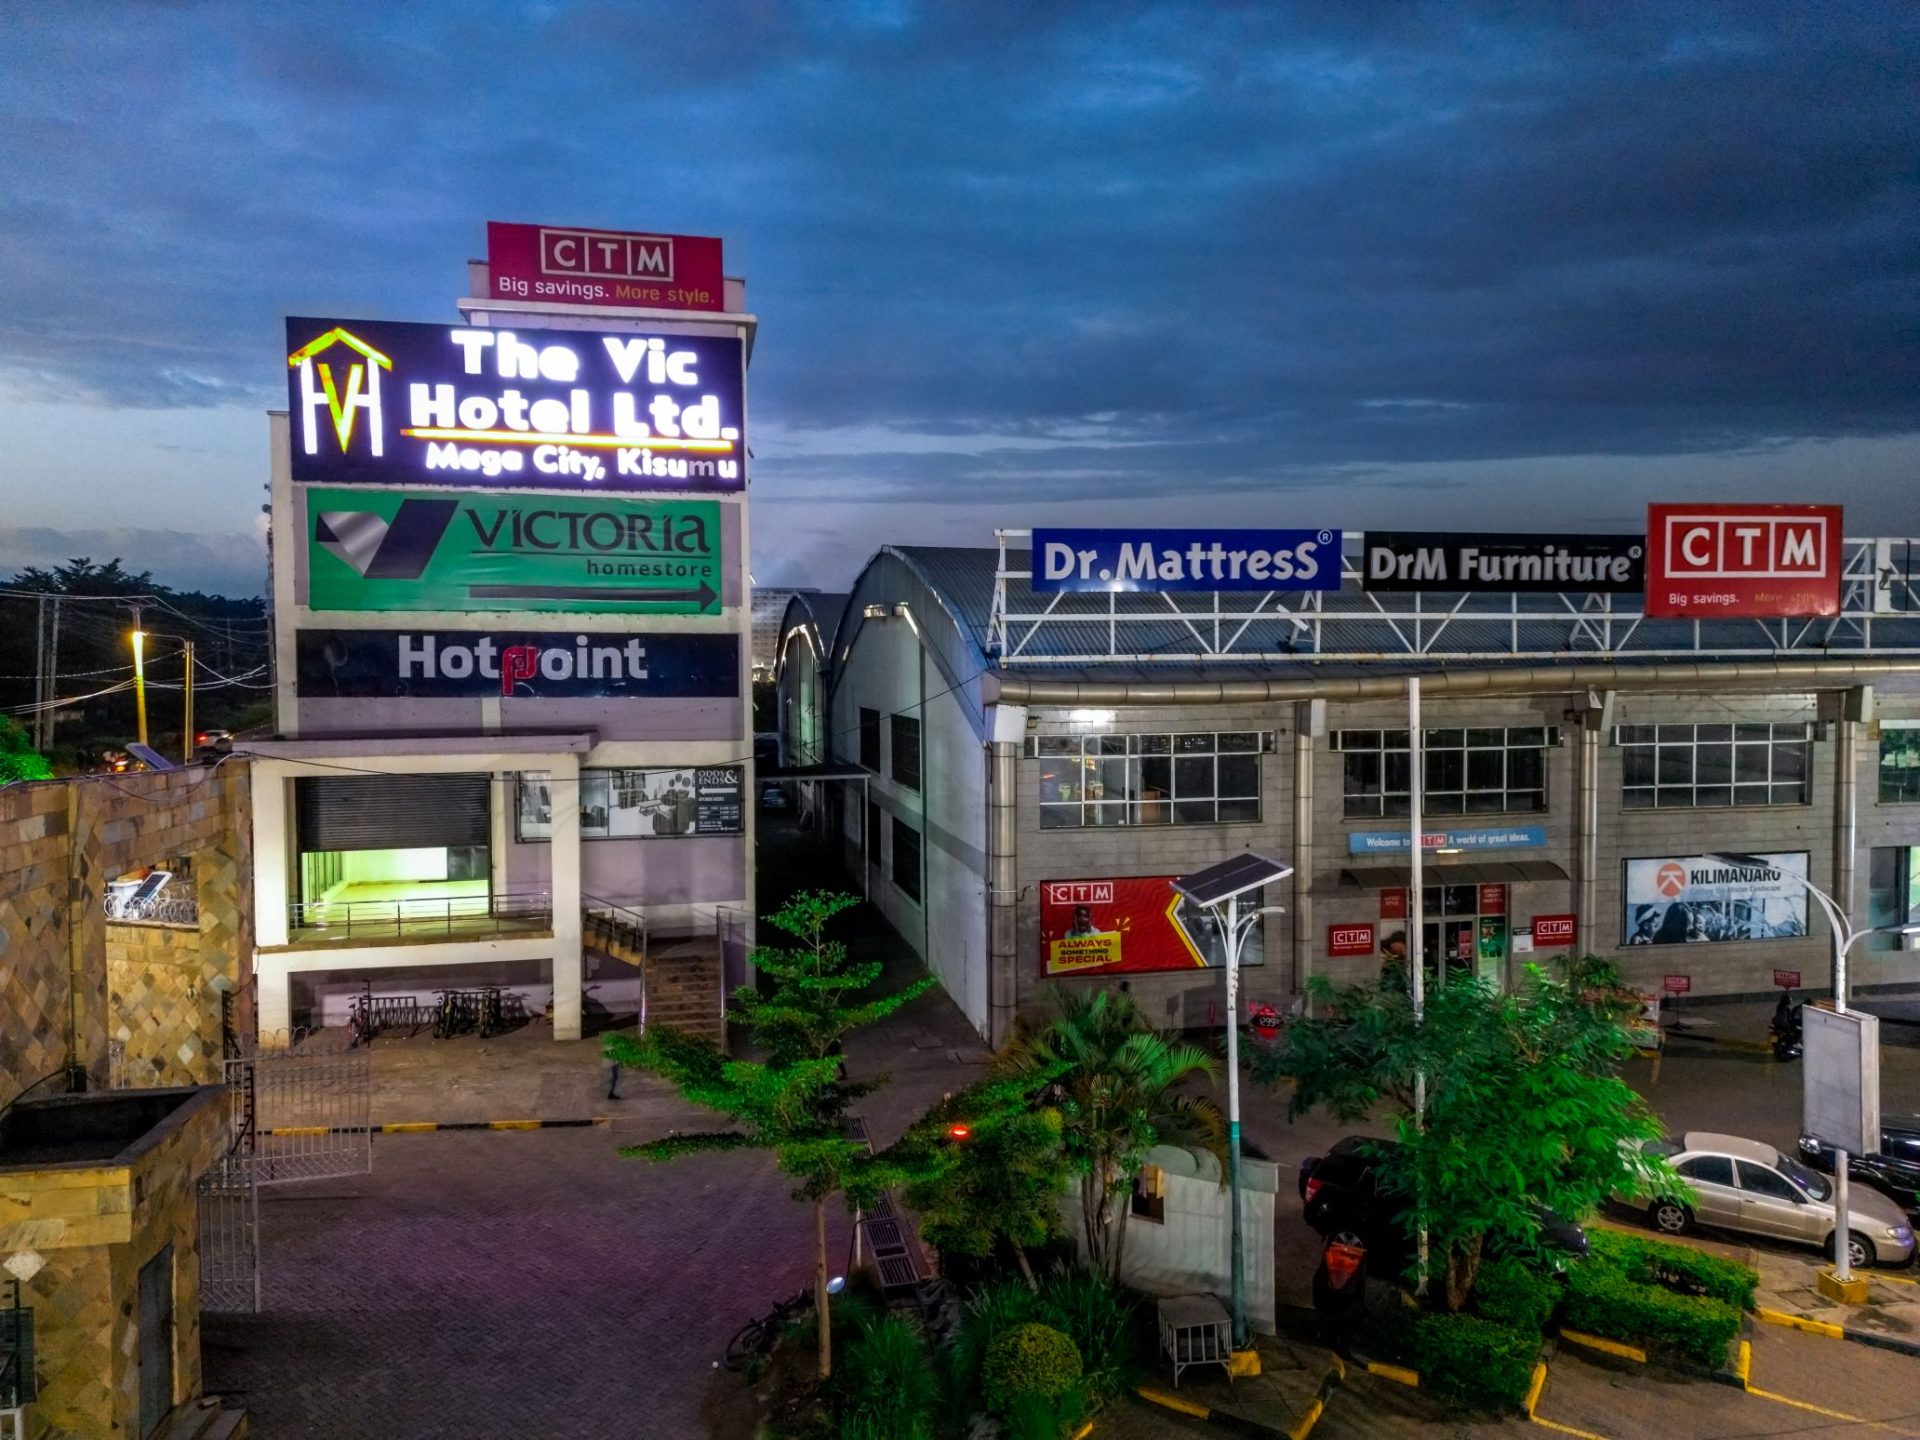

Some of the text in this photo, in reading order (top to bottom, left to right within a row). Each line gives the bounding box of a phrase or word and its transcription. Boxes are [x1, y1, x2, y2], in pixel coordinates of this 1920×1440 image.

[554, 240, 665, 273] CTM
[499, 277, 715, 305] Big savings. More style.
[451, 330, 698, 385] The Vic
[410, 383, 739, 439] Hotel Ltd.
[425, 442, 738, 480] Mega City, Kisumu
[1682, 527, 1816, 567] CTM
[586, 559, 712, 577] homestore
[1371, 547, 1447, 581] DrM
[1669, 593, 1688, 606] Big
[1693, 593, 1739, 606] savings.
[398, 635, 649, 696] Hotpoint
[1366, 837, 1400, 847] Welcome
[1402, 838, 1411, 846] to
[1056, 886, 1110, 900] CTM
[1540, 923, 1571, 933] CTM
[1058, 939, 1112, 949] ALWAYS
[1337, 933, 1368, 942] CTM
[1058, 954, 1113, 964] SPECIAL
[1060, 948, 1109, 956] SOMETHING
